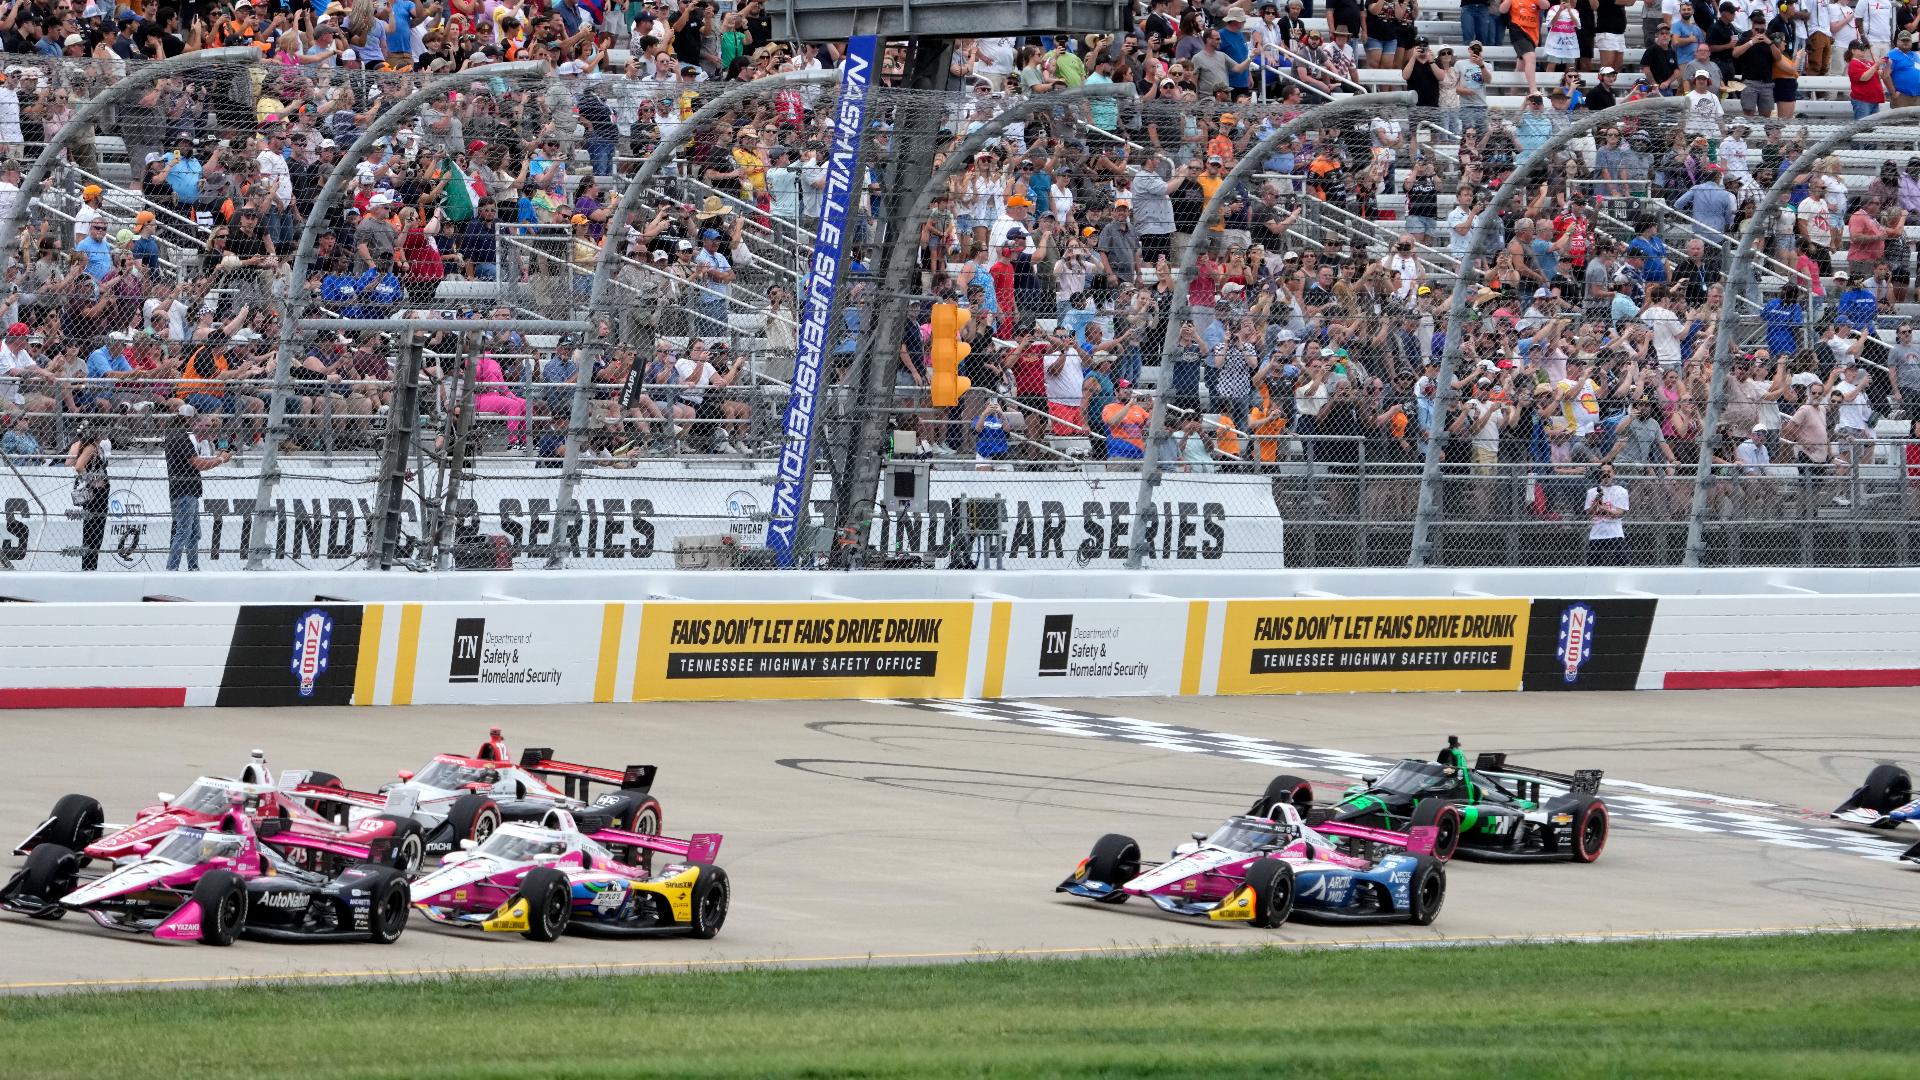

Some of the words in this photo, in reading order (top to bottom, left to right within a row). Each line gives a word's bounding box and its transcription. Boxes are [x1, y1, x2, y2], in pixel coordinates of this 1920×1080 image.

[818, 51, 872, 244] NASHVILLE
[622, 369, 637, 407] MYLAPS
[772, 253, 838, 548] SUPERSPEEDWAY
[499, 498, 655, 559] SERIES
[729, 523, 763, 535] INDYCAR
[1082, 501, 1225, 560] SERIES
[670, 619, 710, 645] FANS
[713, 616, 762, 644] DON'T
[763, 619, 794, 643] LET
[793, 618, 835, 644] FANS
[836, 618, 884, 643] DRIVE
[884, 617, 943, 643] DRUNK
[1074, 627, 1111, 640] Department
[1112, 626, 1120, 638] of
[1253, 617, 1293, 641] FANS
[1295, 614, 1344, 640] DON'T
[1345, 616, 1374, 640] LET
[1374, 615, 1413, 639] FANS
[1414, 615, 1461, 639] DRIVE
[1461, 614, 1518, 639] DRUNK
[303, 619, 321, 674] NSS
[485, 632, 523, 646] Department
[524, 632, 532, 643] of
[1046, 631, 1067, 654] TN
[1567, 613, 1584, 662] NSS
[457, 635, 479, 659] TN
[1071, 644, 1098, 659] Safety
[1099, 644, 1107, 657] &
[483, 650, 510, 664] Safety
[511, 650, 519, 663] &
[681, 658, 753, 672] TENNESSEE
[760, 658, 816, 671] HIGHWAY
[822, 657, 870, 671] SAFETY
[876, 657, 922, 670] OFFICE
[1263, 653, 1334, 667] TENNESSEE
[1340, 652, 1395, 666] HIGHWAY
[1402, 652, 1447, 665] SAFETY
[1454, 651, 1498, 664] OFFICE
[481, 669, 525, 684] Homeland
[526, 668, 562, 686] Security
[1070, 663, 1112, 677] Homeland
[1113, 662, 1148, 679] Security
[496, 742, 509, 760] 12
[257, 891, 311, 908] AutoNation
[177, 923, 200, 931] YAZAKI
